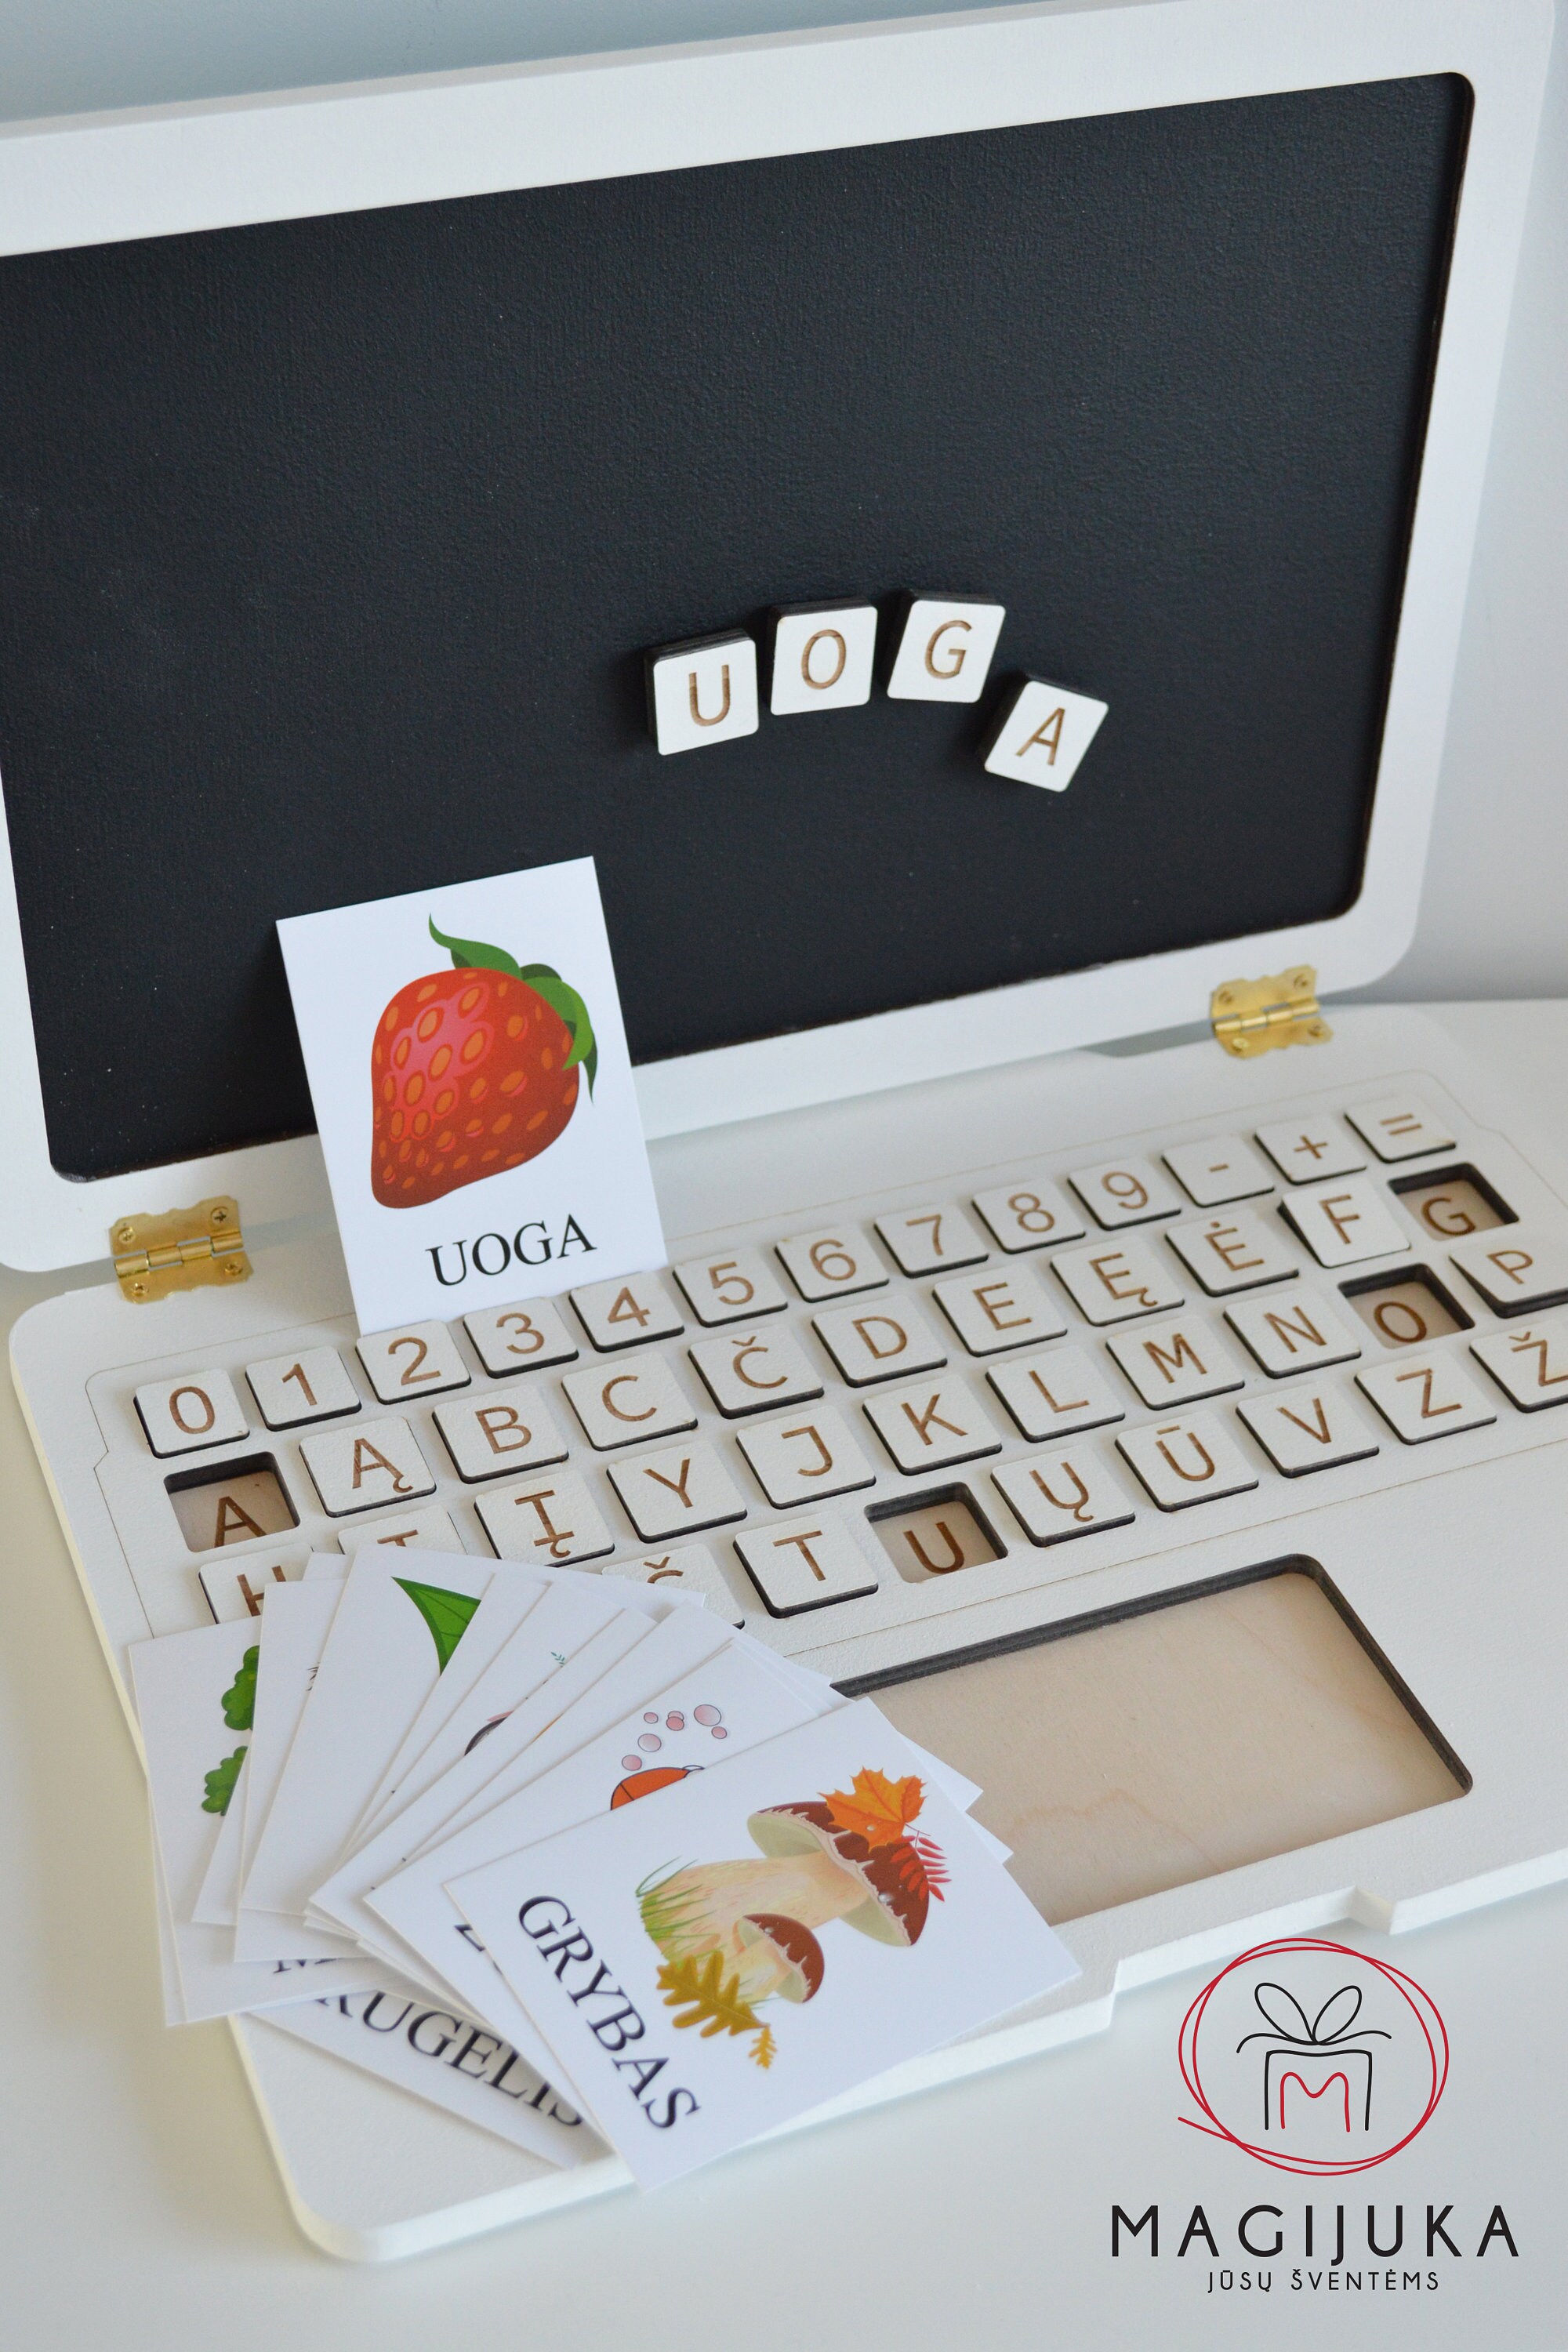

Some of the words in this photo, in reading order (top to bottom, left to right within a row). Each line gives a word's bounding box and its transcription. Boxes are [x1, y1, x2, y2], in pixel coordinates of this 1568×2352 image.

[688, 619, 1066, 766] UOGA
[169, 1385, 216, 1434] 0
[281, 1363, 318, 1406] 1
[387, 1336, 441, 1385] 2
[496, 1312, 545, 1355] 3
[608, 1287, 650, 1327] 4
[708, 1261, 754, 1305] 5
[809, 1238, 857, 1281] 6
[906, 1214, 944, 1255] 7
[1007, 1192, 1055, 1233] 8
[1102, 1171, 1149, 1210] 9
[1294, 1134, 1328, 1160] +
[1380, 1112, 1423, 1136] =
[213, 1494, 270, 1549] A
[352, 1438, 413, 1494] Ą
[476, 1406, 532, 1454] B
[601, 1374, 657, 1422] C
[731, 1335, 788, 1389] Č
[852, 1316, 908, 1360] D
[972, 1282, 1033, 1330] E
[1090, 1252, 1159, 1308] Ę
[1205, 1221, 1265, 1272] Ė
[1319, 1193, 1361, 1245] F
[1422, 1196, 1476, 1238] G
[425, 1213, 598, 1287] UOGA
[514, 1489, 575, 1559] Į
[643, 1457, 693, 1508] Y
[781, 1425, 833, 1477] J
[900, 1393, 967, 1446] K
[1029, 1370, 1090, 1413] L
[1142, 1332, 1208, 1384] M
[1263, 1305, 1327, 1354] N
[1486, 1249, 1534, 1285] P
[773, 1530, 826, 1582] T
[904, 1521, 965, 1574] U
[1029, 1461, 1094, 1523] Ų
[1154, 1425, 1216, 1482] Ū
[1278, 1397, 1332, 1443] V
[1395, 1367, 1463, 1418] Z
[1509, 1330, 1568, 1387] Ž
[517, 1894, 702, 2129] GRYBAS
